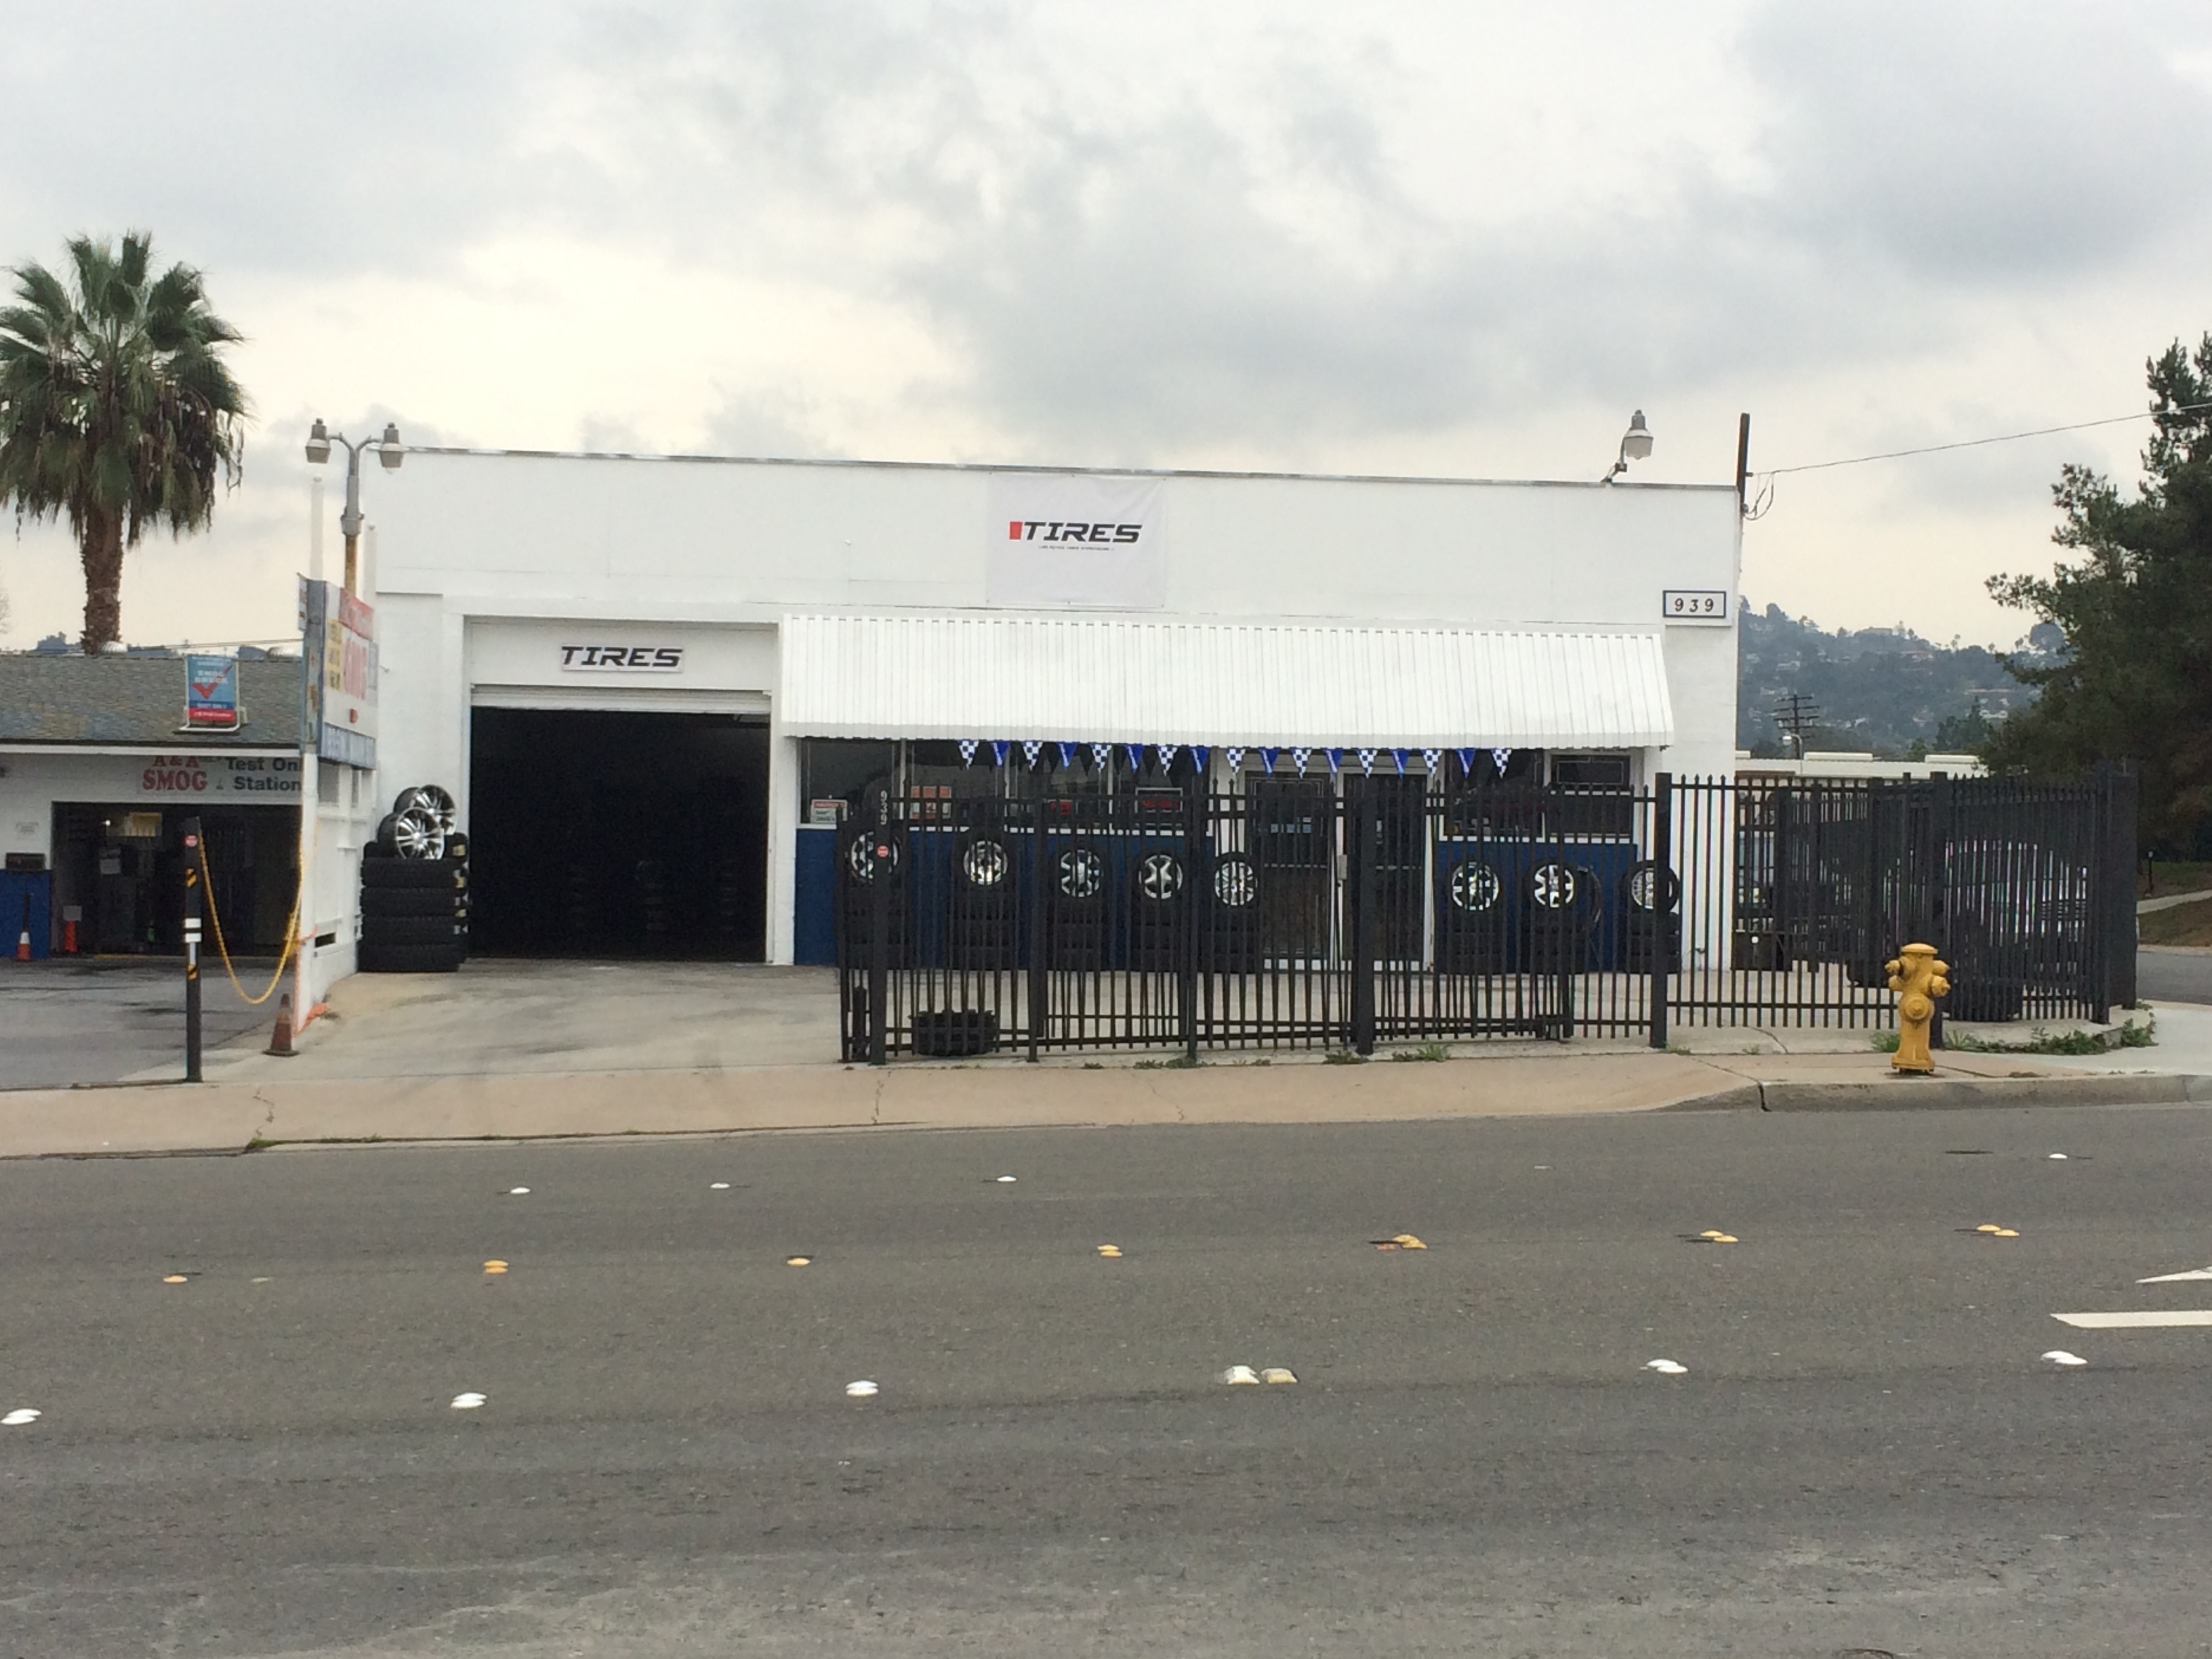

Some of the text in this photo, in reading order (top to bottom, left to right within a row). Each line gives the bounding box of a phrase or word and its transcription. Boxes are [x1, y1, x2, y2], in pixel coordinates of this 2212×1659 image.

[1024, 521, 1143, 543] TIRES
[1675, 598, 1714, 613] 939
[562, 646, 683, 668] TIRES
[226, 756, 265, 771] Test
[142, 769, 208, 792] SMOG
[233, 776, 302, 792] Station
